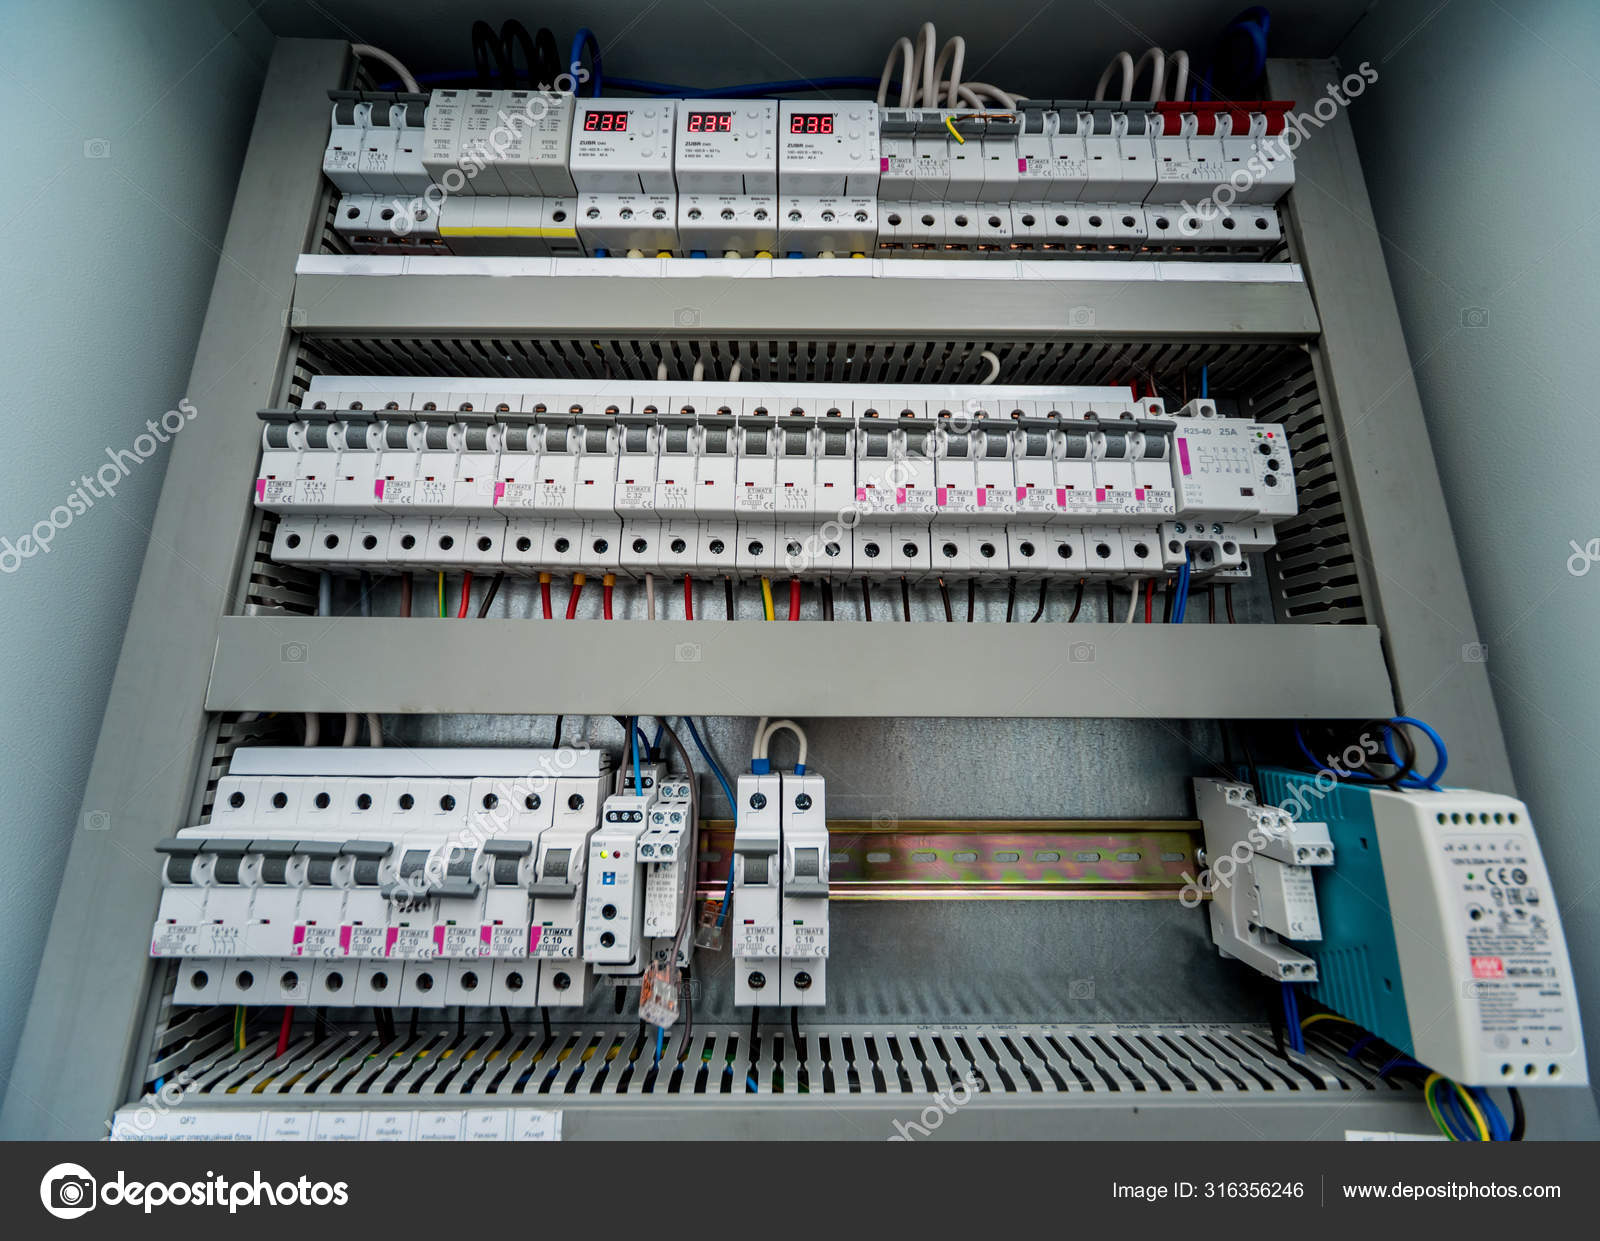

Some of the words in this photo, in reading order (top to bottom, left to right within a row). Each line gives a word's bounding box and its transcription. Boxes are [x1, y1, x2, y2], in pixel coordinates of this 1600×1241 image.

[586, 113, 626, 131] 235
[689, 115, 731, 132] 234
[791, 117, 832, 133] 236
[1219, 427, 1238, 436] 25A
